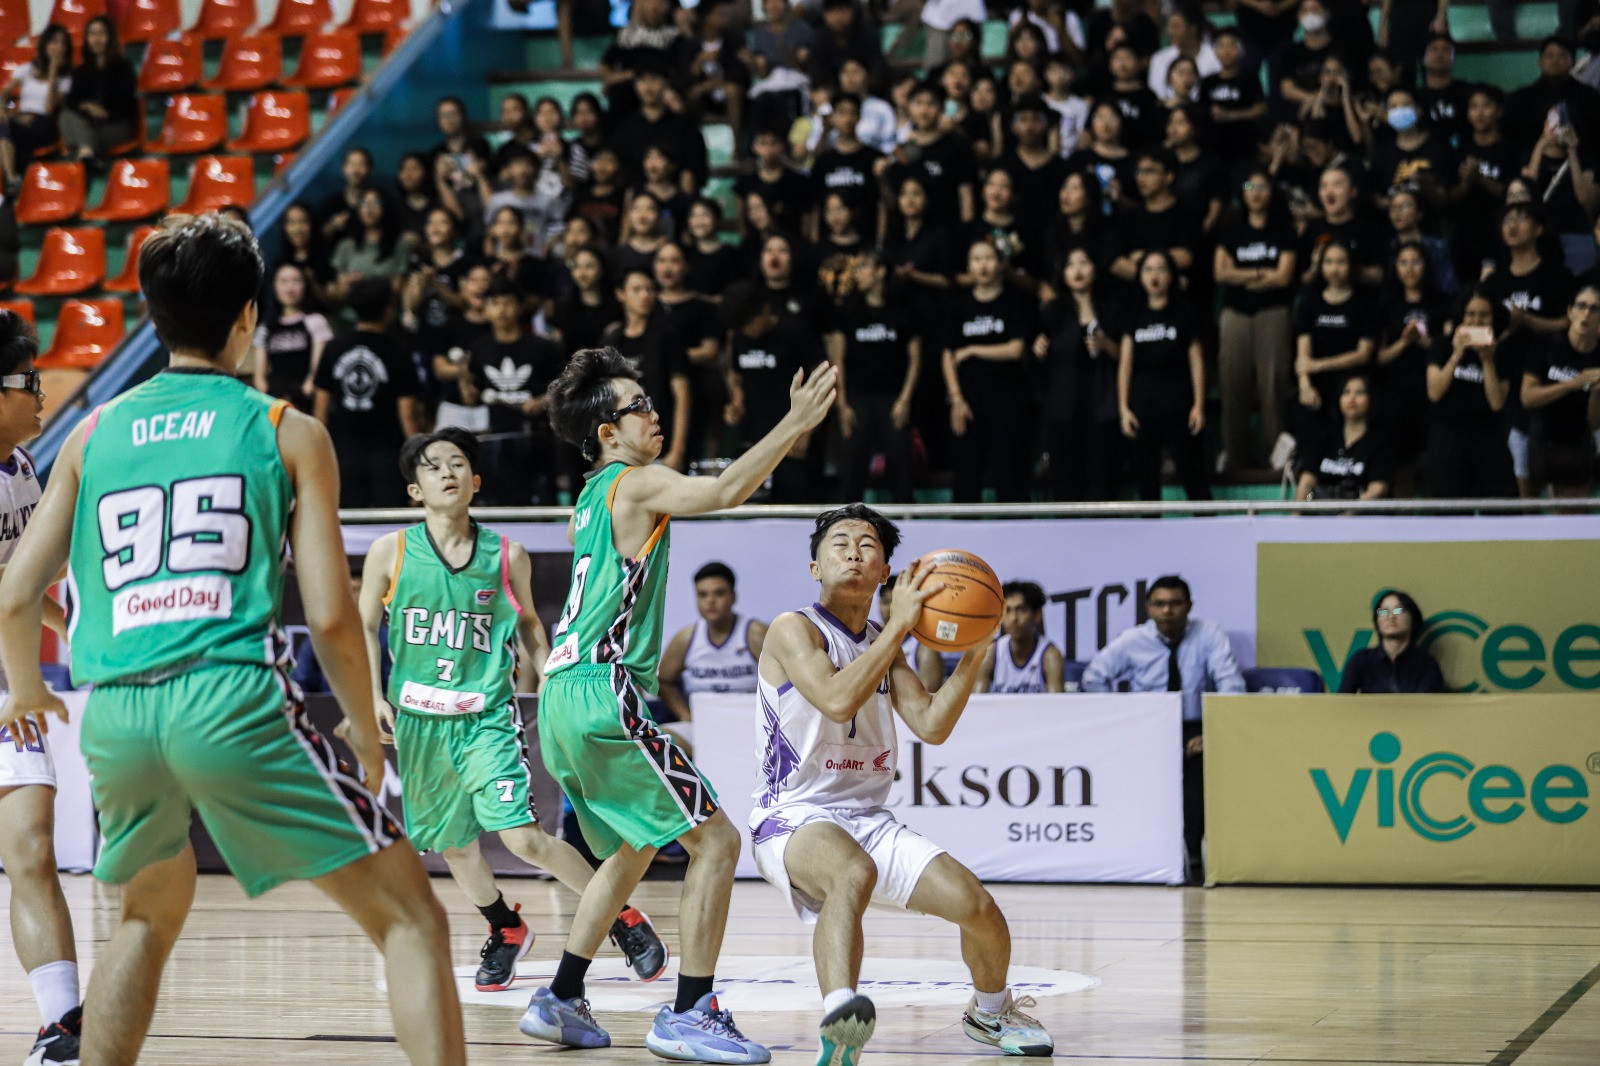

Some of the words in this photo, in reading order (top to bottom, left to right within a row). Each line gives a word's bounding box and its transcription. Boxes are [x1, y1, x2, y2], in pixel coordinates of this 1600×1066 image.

[132, 411, 216, 446] OCEAN
[98, 474, 253, 592] 95
[436, 658, 455, 682] 7
[495, 779, 515, 802] 7
[1008, 823, 1095, 842] SHOES
